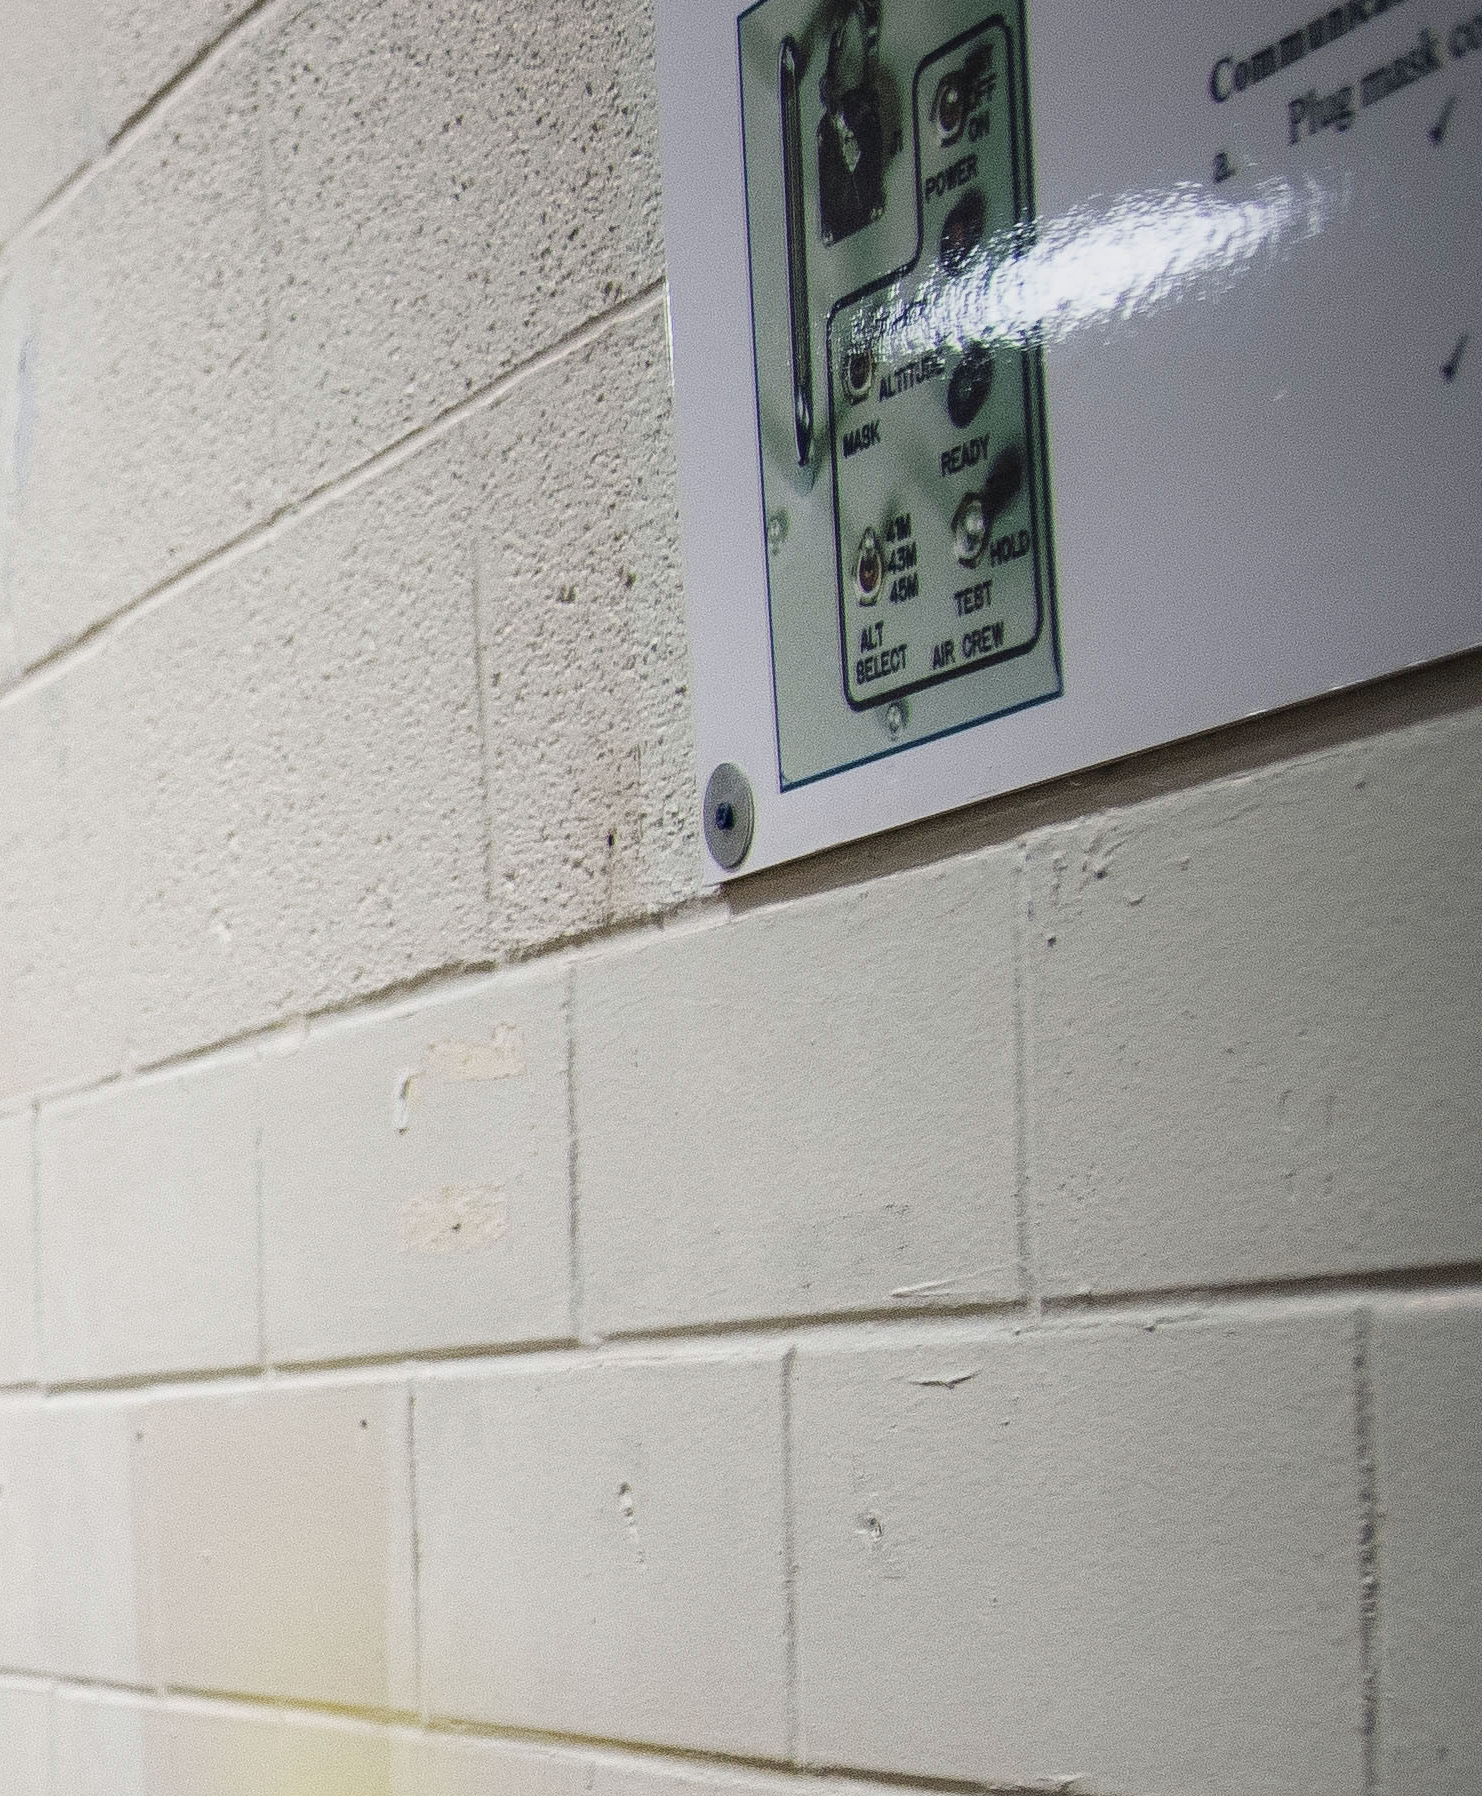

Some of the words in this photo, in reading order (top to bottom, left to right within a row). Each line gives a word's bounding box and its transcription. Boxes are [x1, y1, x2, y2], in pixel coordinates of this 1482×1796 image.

[1287, 86, 1355, 146] Plug
[1360, 27, 1443, 108] mask
[967, 111, 991, 142] ON
[925, 154, 979, 202] POWER
[842, 419, 882, 458] MASK
[940, 433, 991, 477] READY
[989, 529, 1031, 568] HOLD
[890, 572, 920, 604] 45M
[953, 579, 993, 617] TEST
[860, 620, 884, 653] ALT
[932, 639, 956, 670] AIR
[961, 621, 1005, 659] CREW
[855, 643, 908, 685] SELECT
